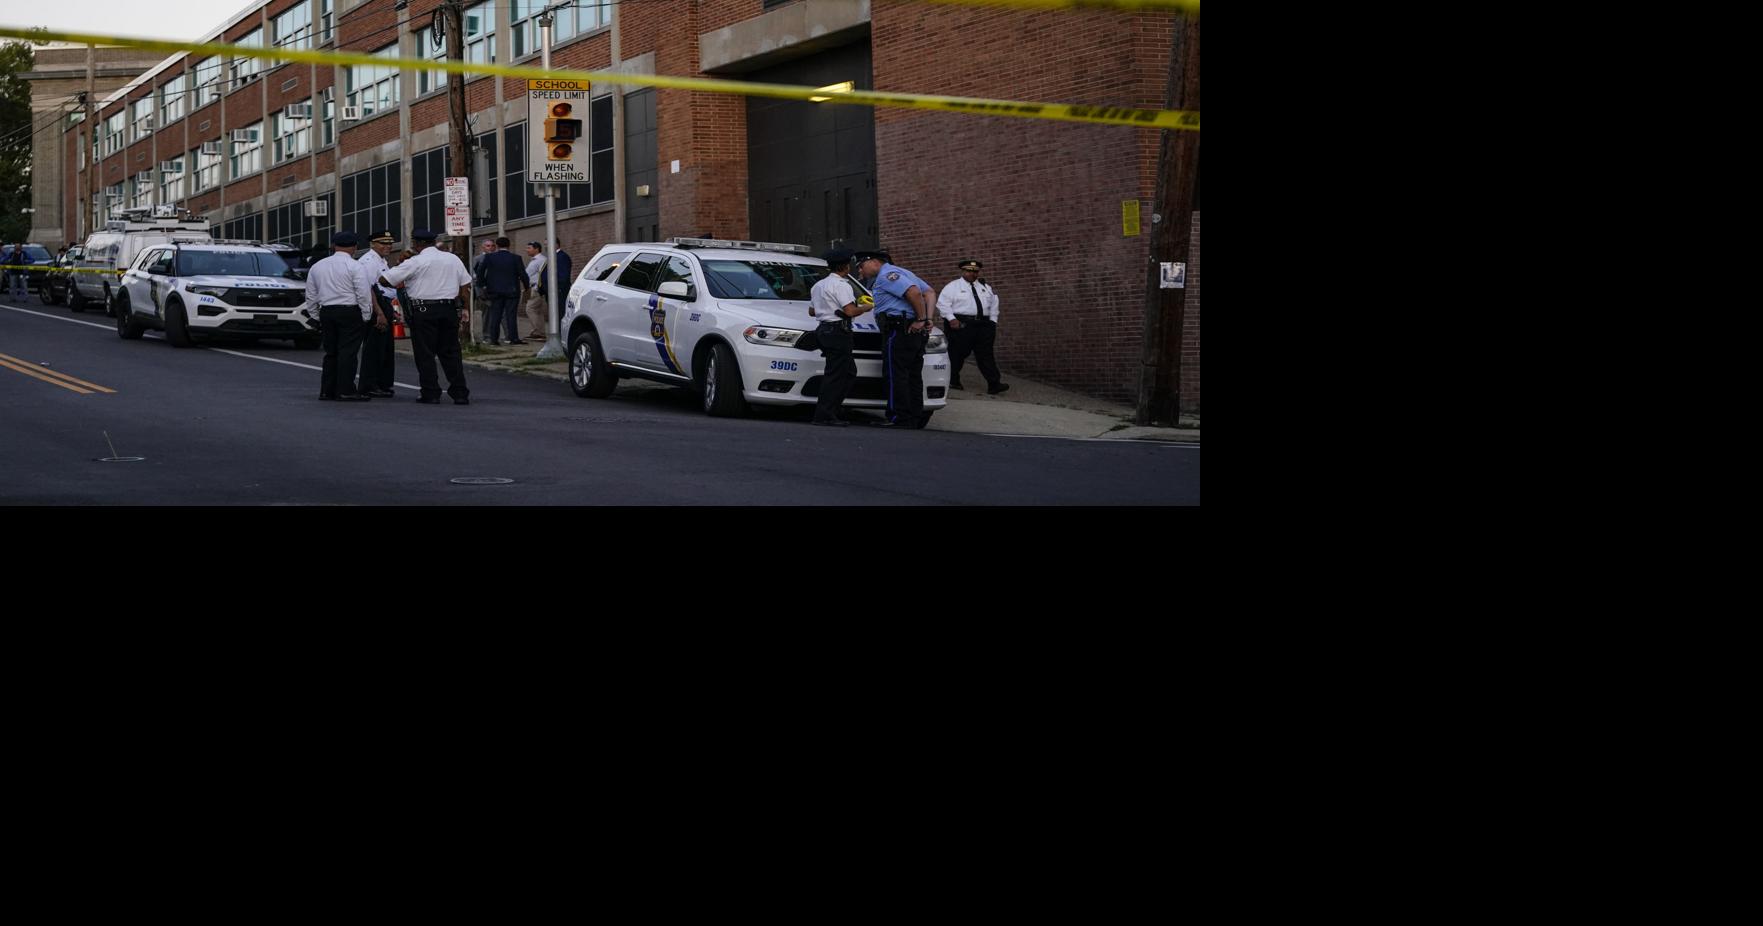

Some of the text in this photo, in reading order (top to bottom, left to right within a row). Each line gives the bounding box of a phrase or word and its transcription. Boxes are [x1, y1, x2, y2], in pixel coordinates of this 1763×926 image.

[535, 80, 583, 89] SCHOOL
[532, 91, 560, 99] SPEED
[545, 163, 574, 171] WHEN
[534, 172, 584, 181] FLASHING
[770, 360, 798, 372] 39DC
